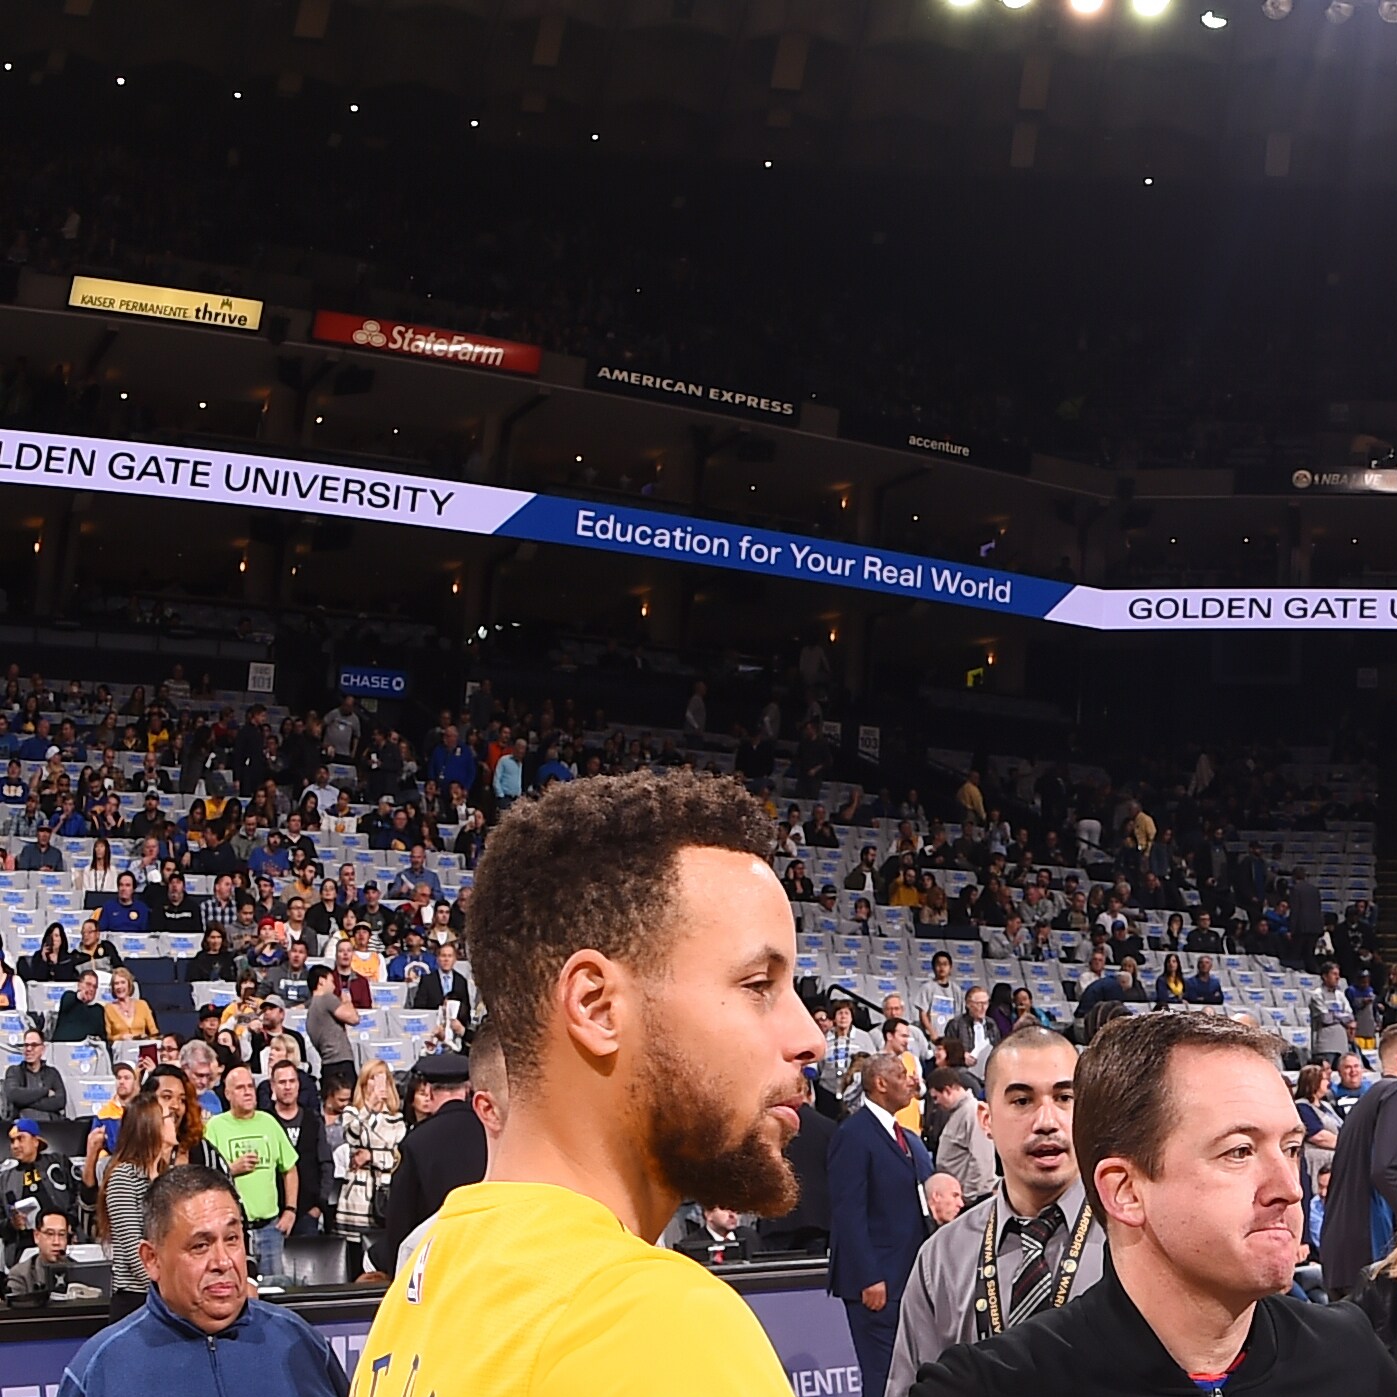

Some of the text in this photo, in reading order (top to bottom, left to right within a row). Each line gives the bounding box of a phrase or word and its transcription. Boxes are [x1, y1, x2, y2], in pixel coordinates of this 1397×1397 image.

[81, 294, 247, 326] KAISER PERMANENTE thrive
[597, 367, 794, 415] AMERICAN EXPRESS
[908, 435, 970, 457] accenture
[107, 452, 213, 489] GATE
[224, 463, 455, 516] UNIVERSITY
[575, 510, 1011, 603] Education for Your Real World
[1128, 597, 1272, 620] GOLDEN
[1283, 597, 1377, 620] GATE
[340, 673, 389, 689] CHASE
[986, 1279, 1003, 1334] ARRIORS
